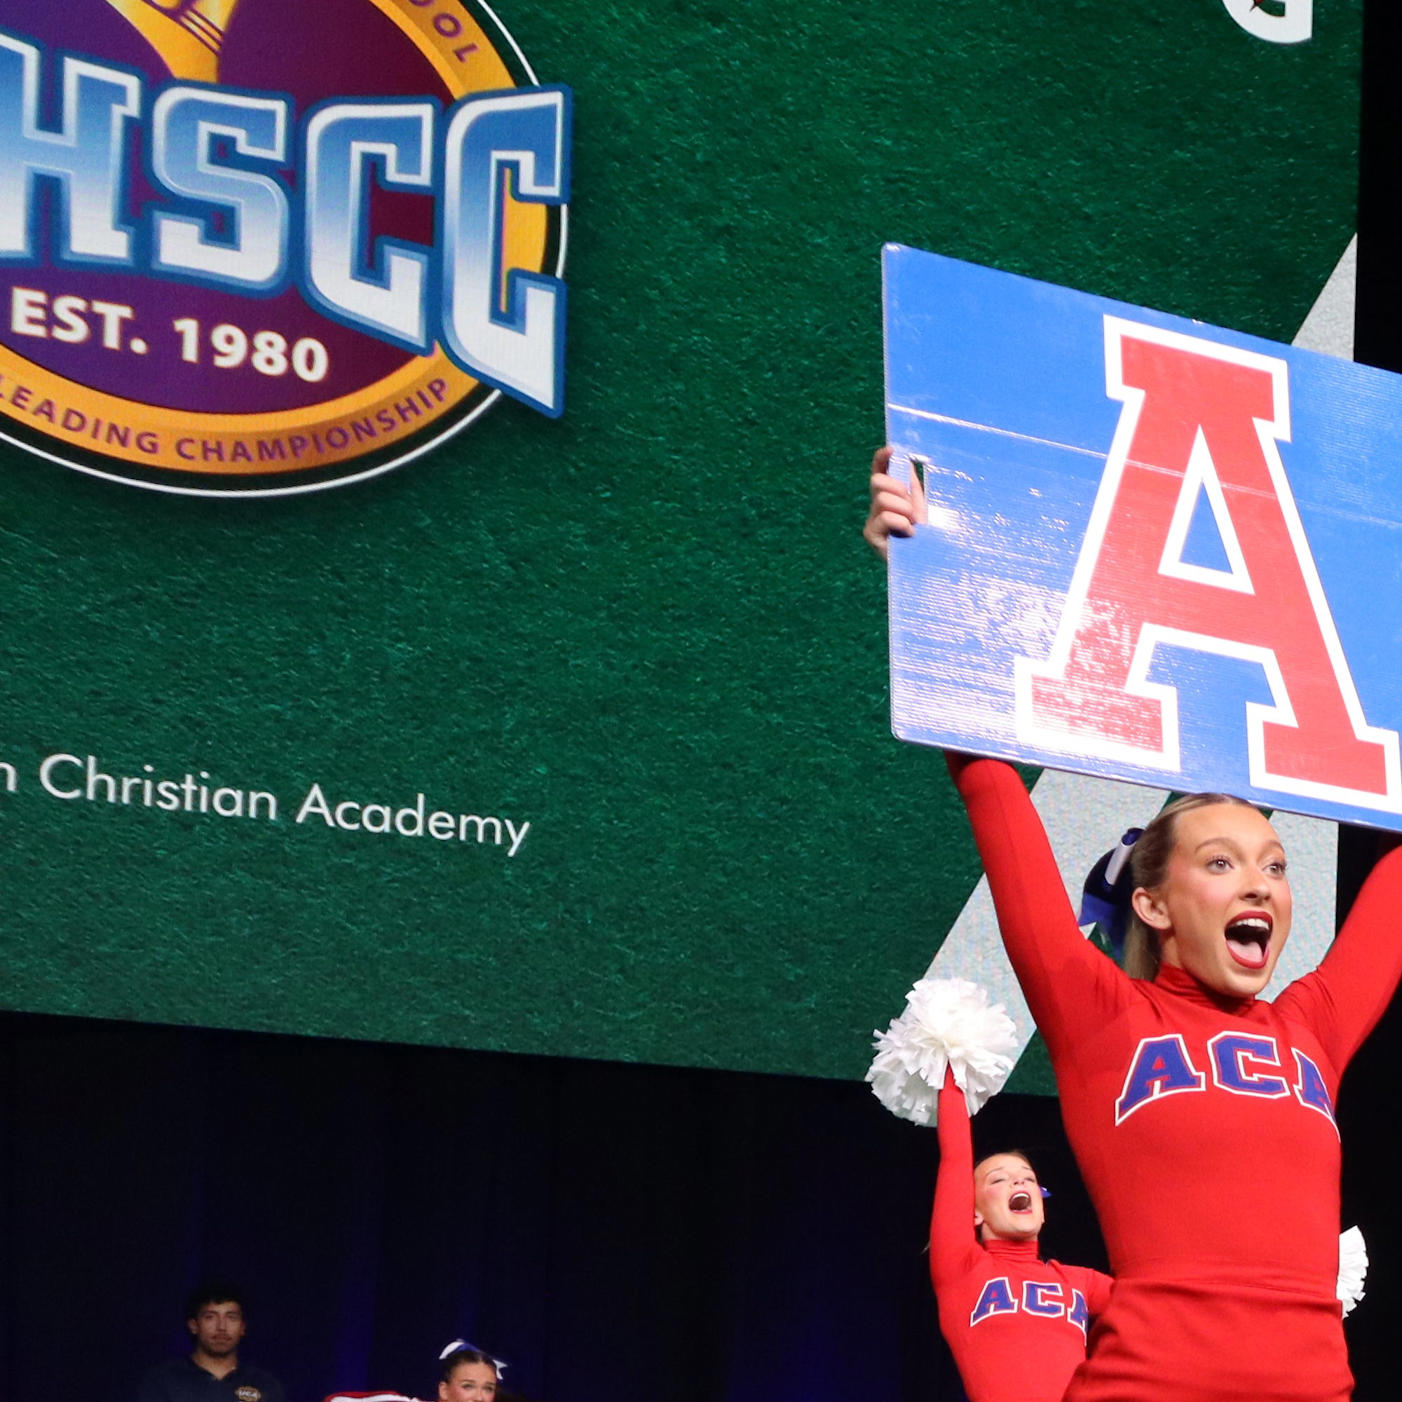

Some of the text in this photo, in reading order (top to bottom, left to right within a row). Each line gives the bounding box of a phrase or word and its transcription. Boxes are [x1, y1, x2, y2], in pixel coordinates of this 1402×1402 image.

[10, 286, 329, 383] EST. 1980
[175, 376, 450, 465] CHAMPIONSHIP
[39, 753, 277, 820] Christian
[296, 784, 530, 858] Academy
